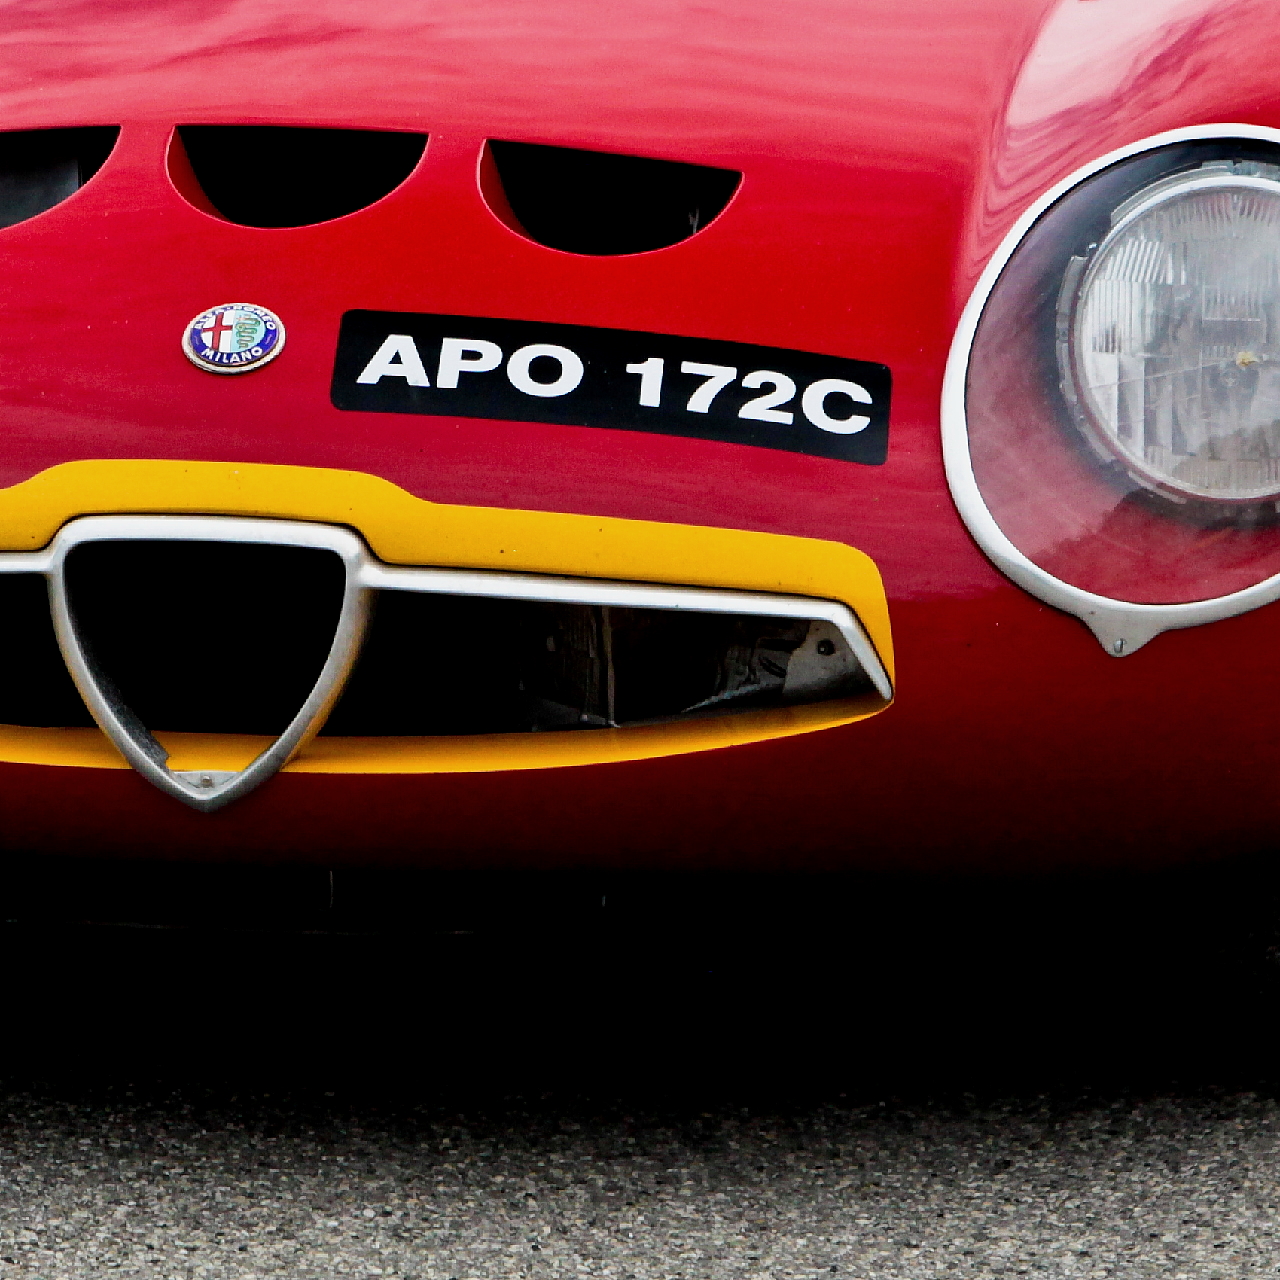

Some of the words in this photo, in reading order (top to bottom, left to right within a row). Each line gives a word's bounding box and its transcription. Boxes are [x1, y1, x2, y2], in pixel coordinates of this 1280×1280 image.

[201, 346, 263, 363] MILANO
[356, 335, 584, 397] APO
[625, 358, 873, 435] 172C
